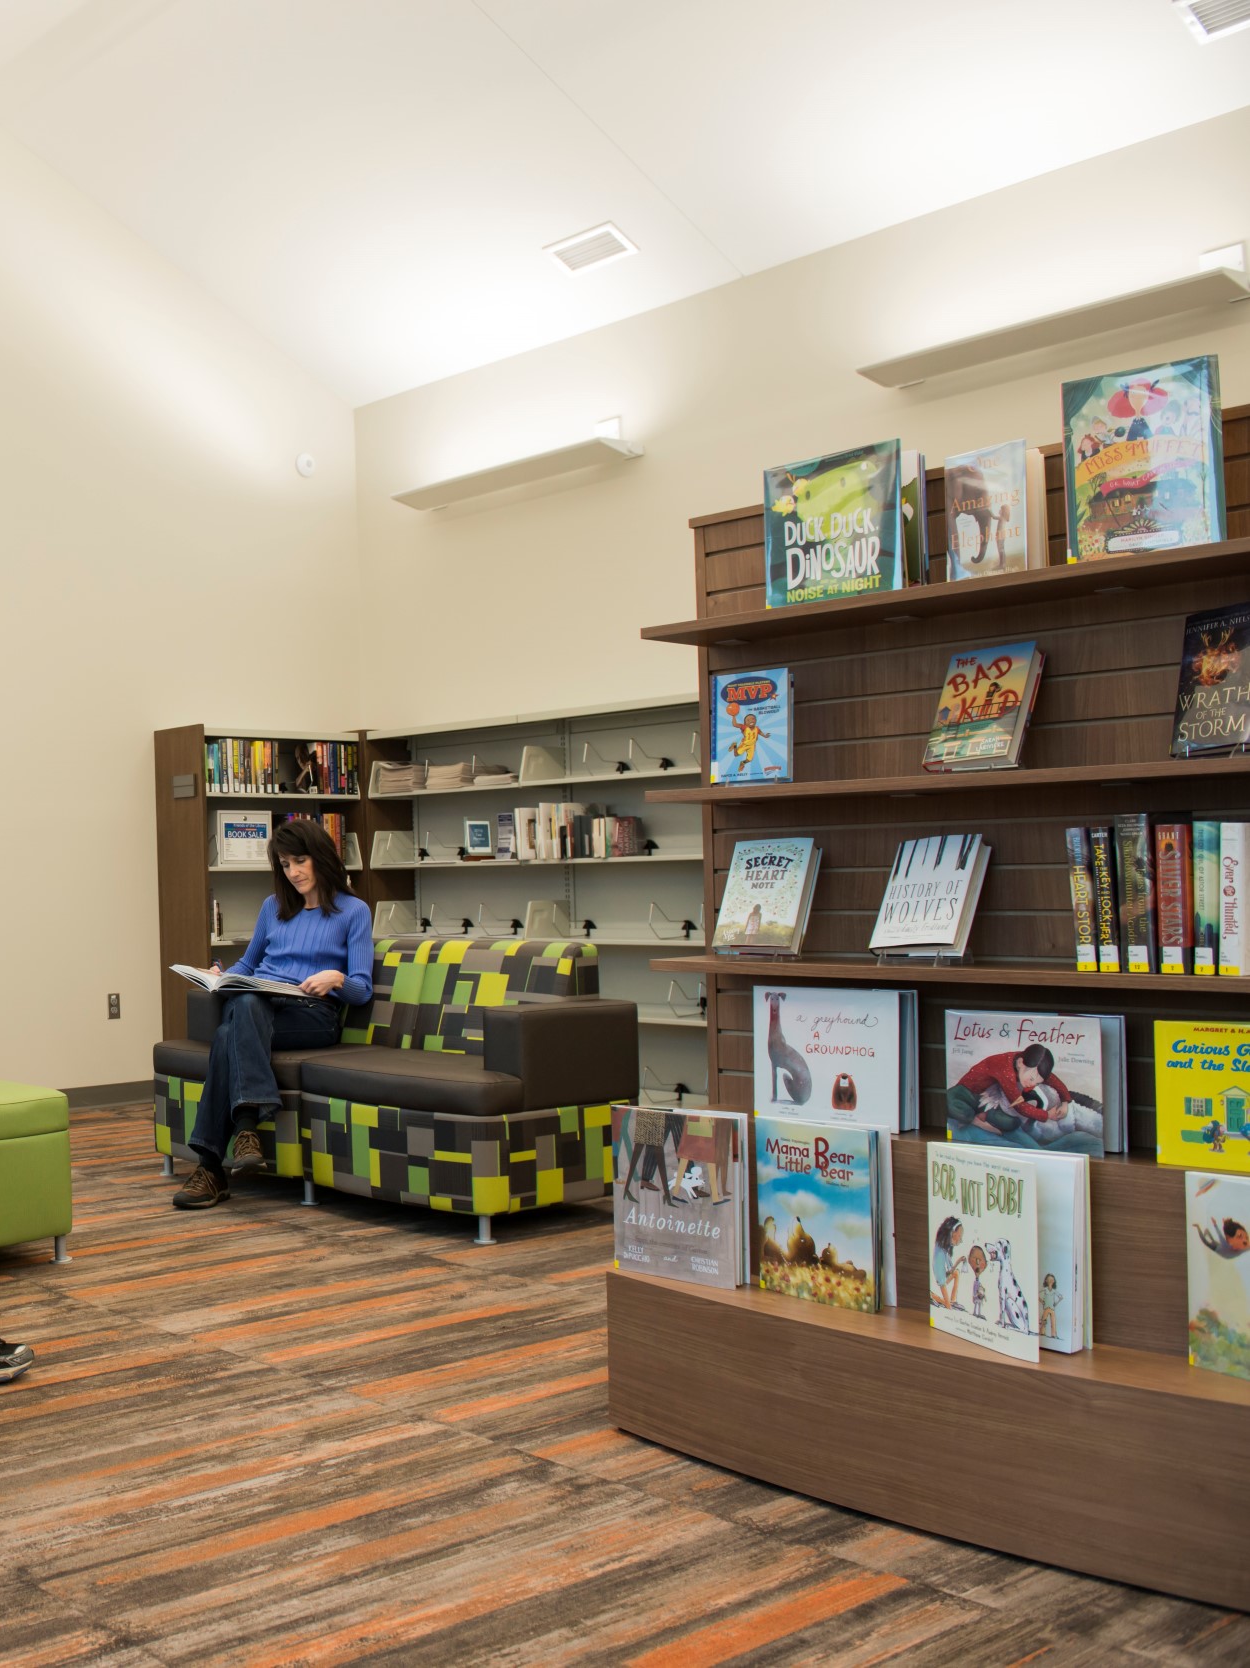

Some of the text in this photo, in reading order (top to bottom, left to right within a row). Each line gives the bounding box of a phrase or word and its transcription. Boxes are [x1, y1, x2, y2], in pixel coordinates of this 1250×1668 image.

[1085, 439, 1200, 475] MISS MUFFET
[950, 489, 1020, 513] Amazing
[951, 526, 1022, 550] Elephant
[786, 584, 825, 603] NOISE
[827, 583, 838, 595] AT
[841, 574, 882, 594] NIGHT
[1186, 621, 1219, 635] JENNIFER
[956, 657, 977, 669] THE
[947, 655, 1013, 698] BAD
[727, 683, 772, 702] MVP
[1178, 682, 1250, 712] WRATH
[956, 689, 1019, 725] KID
[1196, 707, 1227, 720] OF THE
[1178, 713, 1246, 742] STORM
[227, 830, 264, 839] BOOK SALE
[1158, 831, 1179, 841] GRANT
[745, 855, 794, 870] SECRET
[1094, 844, 1105, 867] TAKE
[745, 869, 788, 881] HEART
[1099, 871, 1111, 889] KEY
[1122, 840, 1134, 910] Shadowhunter
[1159, 850, 1181, 898] SILVER
[1222, 856, 1239, 883] Ever
[889, 880, 963, 900] HISTORY OF
[1073, 865, 1088, 906] HEART
[884, 897, 959, 925] WOLVES
[1100, 895, 1113, 921] LOCK
[1139, 891, 1149, 914] from
[1077, 911, 1092, 946] STOR
[1099, 922, 1111, 940] HER
[1138, 917, 1149, 932] the
[1161, 902, 1183, 945] STARS
[796, 1011, 879, 1033] a greyhound
[954, 1016, 1086, 1048] Lotus & Feather
[813, 1031, 820, 1041] A
[1172, 1038, 1230, 1057] Curious
[805, 1043, 875, 1058] GROUNDHOG
[1070, 1057, 1095, 1066] Downing
[1166, 1058, 1194, 1070] and
[1200, 1059, 1225, 1072] the
[765, 1136, 855, 1171] Mama Bear
[776, 1156, 854, 1182] Little Bear
[961, 1177, 983, 1218] NOT
[986, 1172, 1024, 1218] BOB!
[623, 1206, 721, 1239] Antoinette
[628, 1244, 644, 1254] KELLY
[663, 1255, 679, 1263] and
[690, 1256, 719, 1267] CHRISTIAN
[691, 1263, 719, 1275] ROBINSON
